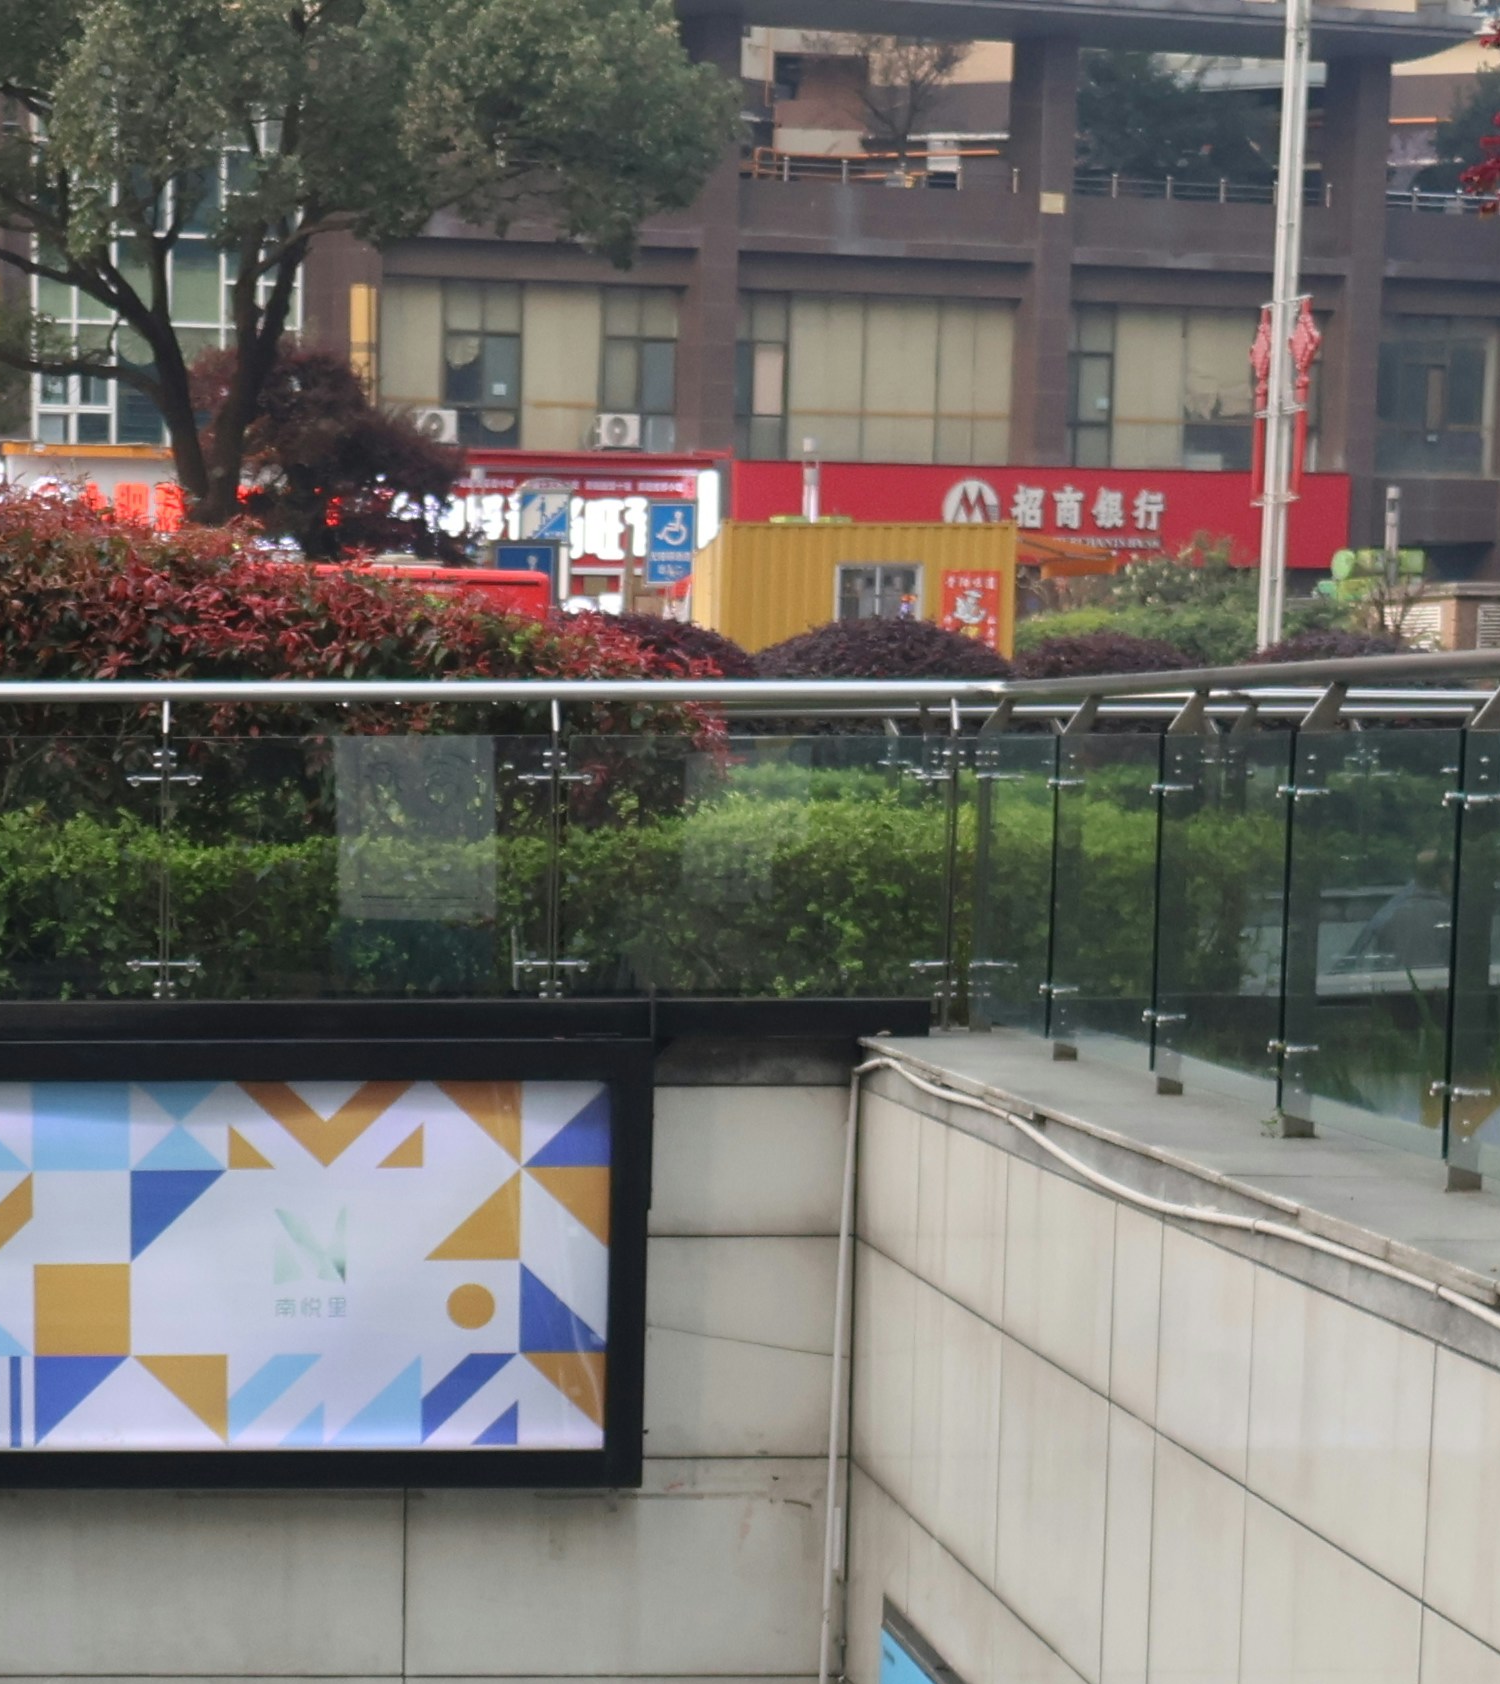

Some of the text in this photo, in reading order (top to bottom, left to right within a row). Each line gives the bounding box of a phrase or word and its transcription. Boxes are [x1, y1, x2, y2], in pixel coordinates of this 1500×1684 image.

[1010, 484, 1166, 531] 招商银行
[273, 1296, 347, 1319] 南悦里
